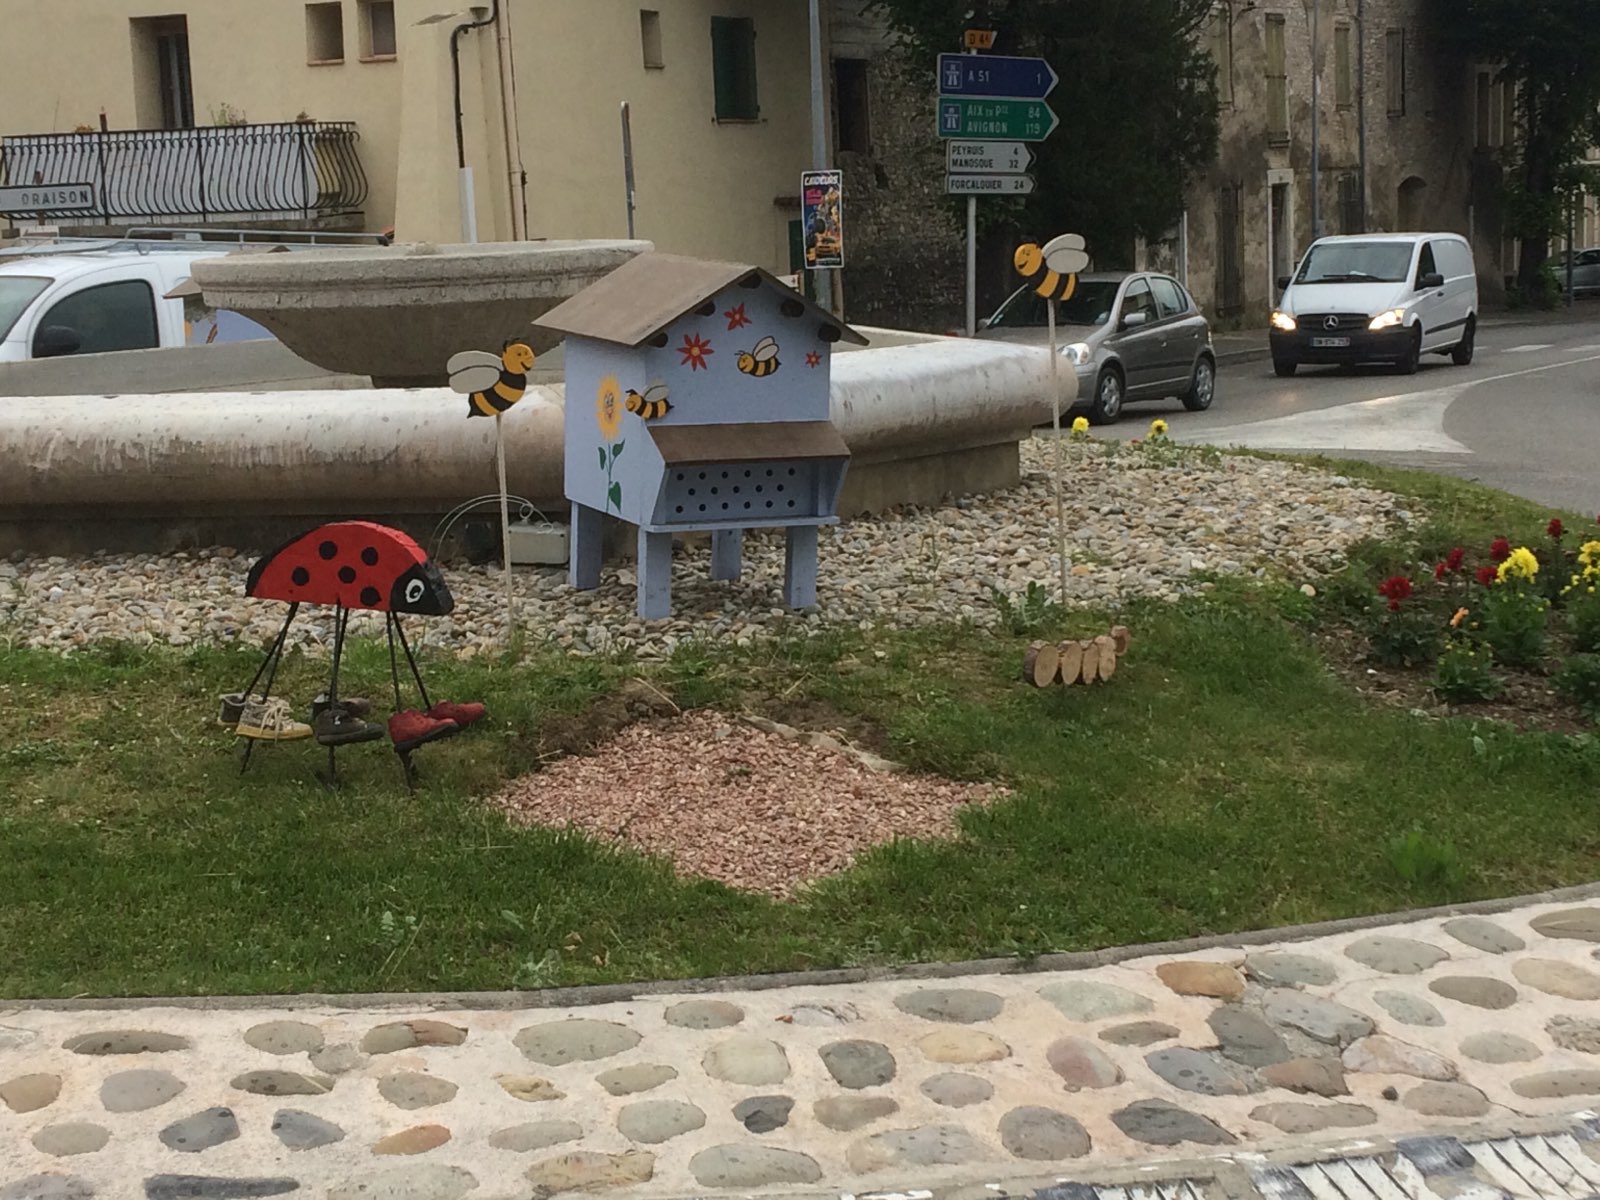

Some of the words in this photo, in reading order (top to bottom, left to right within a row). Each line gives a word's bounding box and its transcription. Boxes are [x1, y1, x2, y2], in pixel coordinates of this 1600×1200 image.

[968, 70, 975, 82] A
[978, 70, 990, 82] 51
[1037, 73, 1041, 85] 1
[967, 104, 983, 117] AIX
[1028, 106, 1040, 119] 84
[967, 121, 1008, 133] AVIGNON
[1025, 122, 1041, 134] 119
[1013, 147, 1019, 156] 4
[952, 158, 994, 169] MANOSQUE
[1008, 159, 1019, 169] 32
[950, 179, 1003, 190] FORCALQUIER
[1013, 180, 1025, 190] 24
[21, 190, 89, 205] ORAISON
